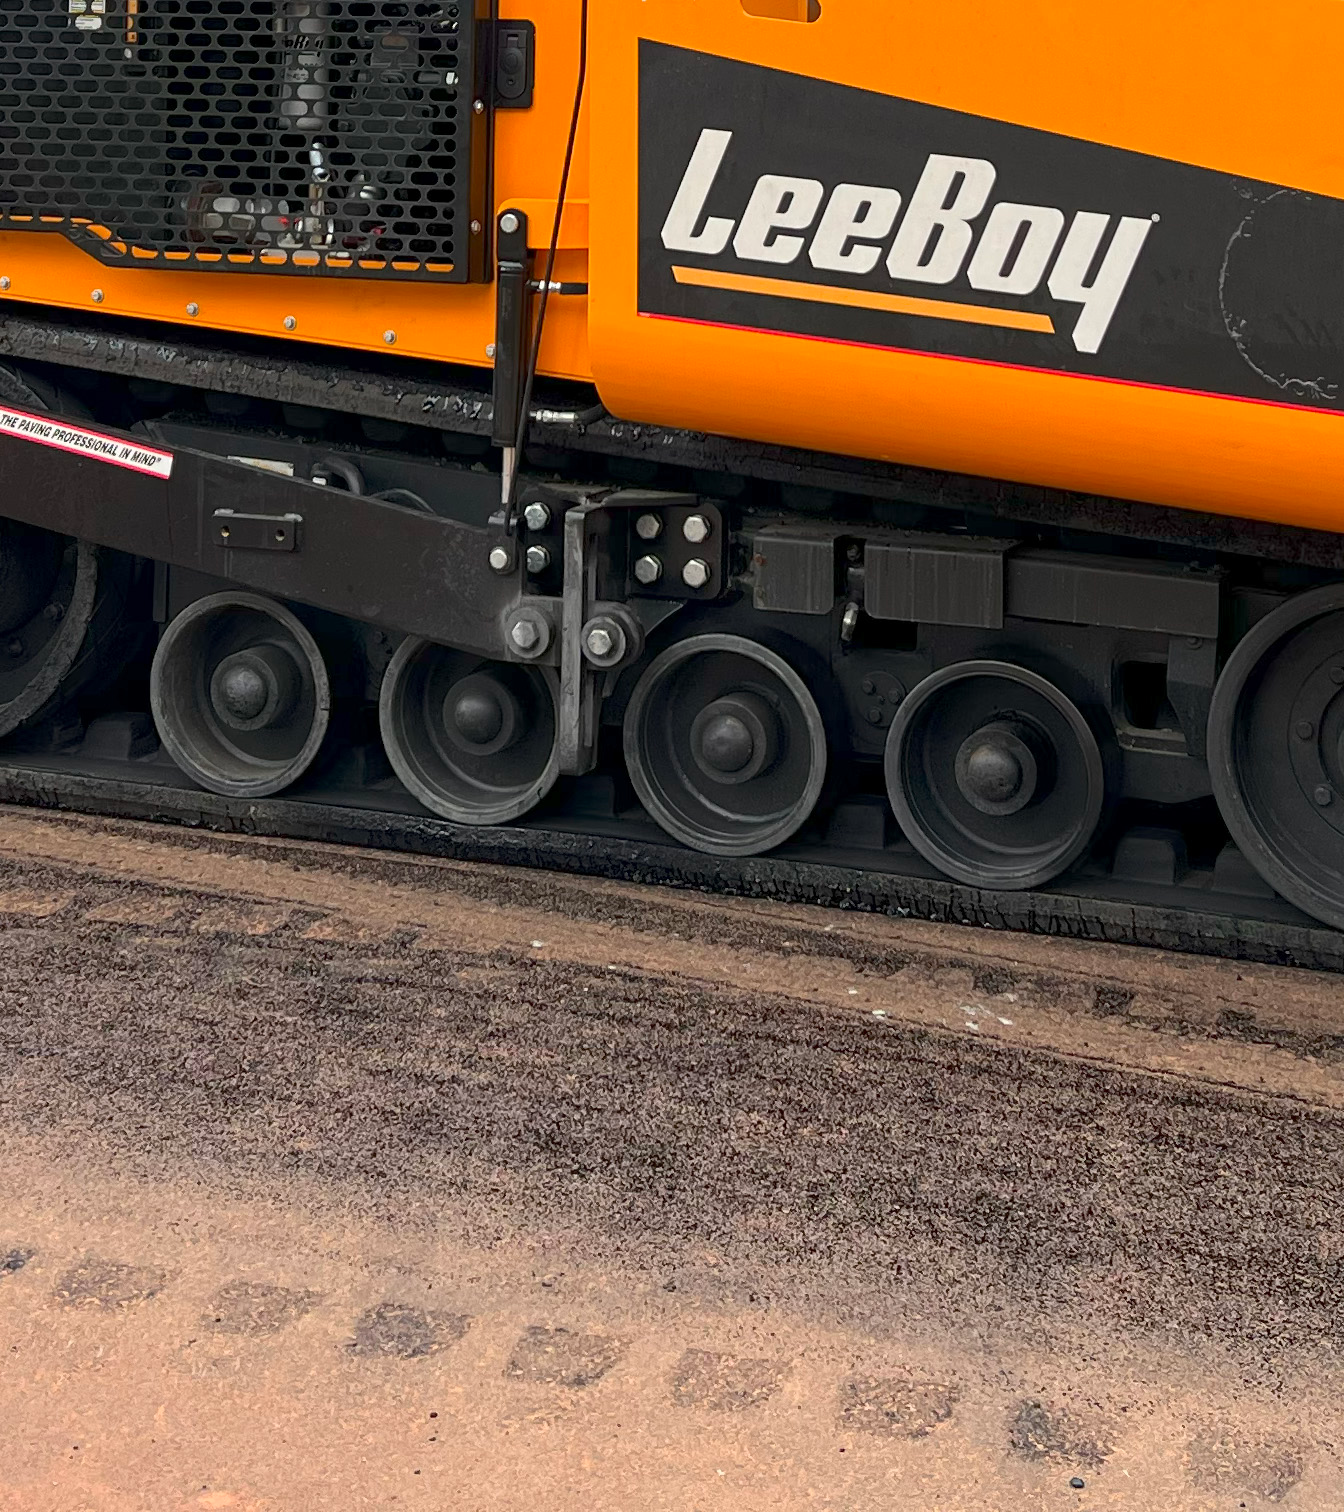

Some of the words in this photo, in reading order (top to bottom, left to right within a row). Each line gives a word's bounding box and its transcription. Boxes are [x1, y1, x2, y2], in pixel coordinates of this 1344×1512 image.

[661, 128, 1153, 354] LeeBoy
[0, 414, 20, 428] THE
[18, 419, 52, 436] PAVING
[51, 428, 117, 457] PROFESSIONAL
[118, 446, 131, 458] IN
